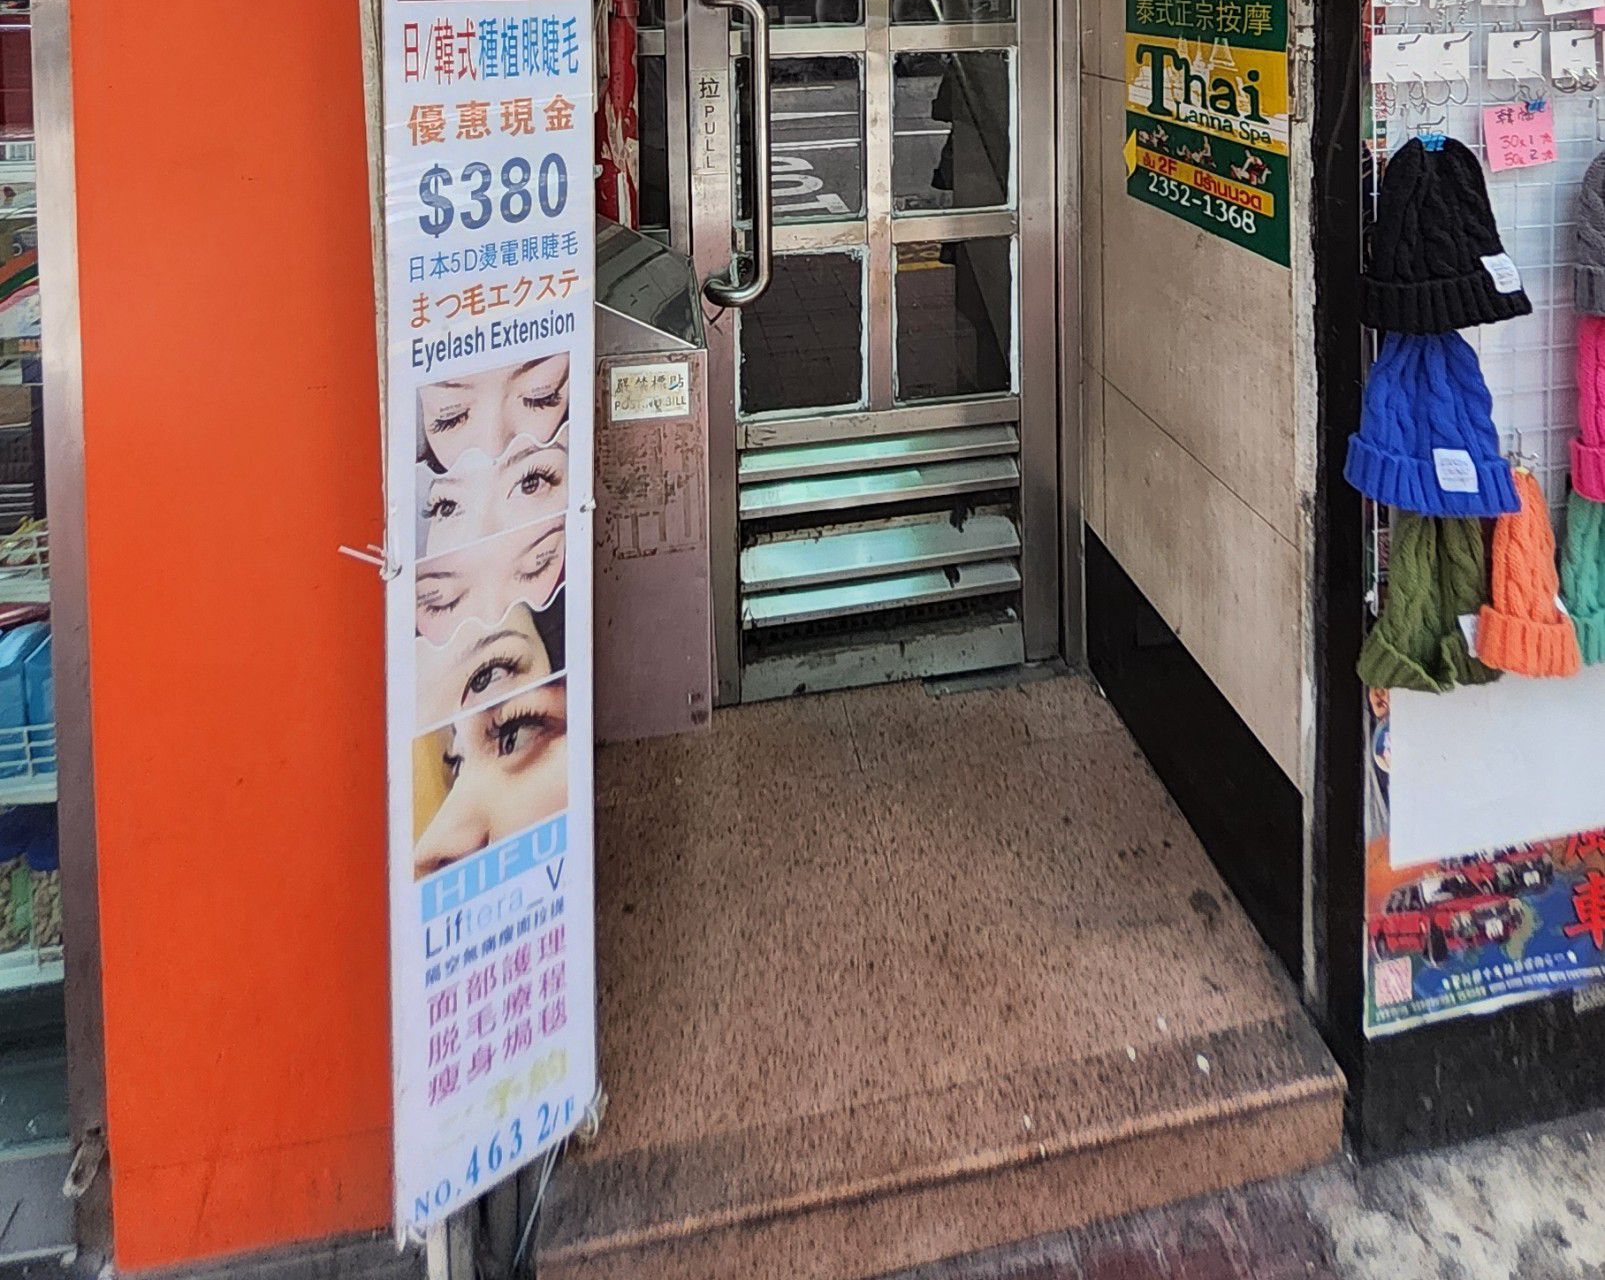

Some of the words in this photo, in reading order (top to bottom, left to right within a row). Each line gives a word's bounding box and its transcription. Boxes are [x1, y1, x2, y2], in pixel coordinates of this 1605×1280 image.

[403, 14, 579, 85] 日/韓式種植眼睫毛
[699, 77, 720, 99] 拉
[1136, 44, 1269, 124] Thai
[406, 94, 576, 146] 優惠現金
[704, 105, 716, 168] PULL
[1175, 101, 1234, 135] Lanna
[1239, 121, 1272, 145] Spa
[418, 152, 569, 238] $380
[1158, 155, 1177, 176] 2F
[1148, 173, 1256, 233] 2352-1368
[408, 231, 579, 283] 日本5D燙電眼睫毛
[409, 269, 579, 329] まつ毛エクステ
[412, 325, 485, 374] Eyelash
[491, 309, 575, 350] Extension
[436, 822, 559, 913] HIFU
